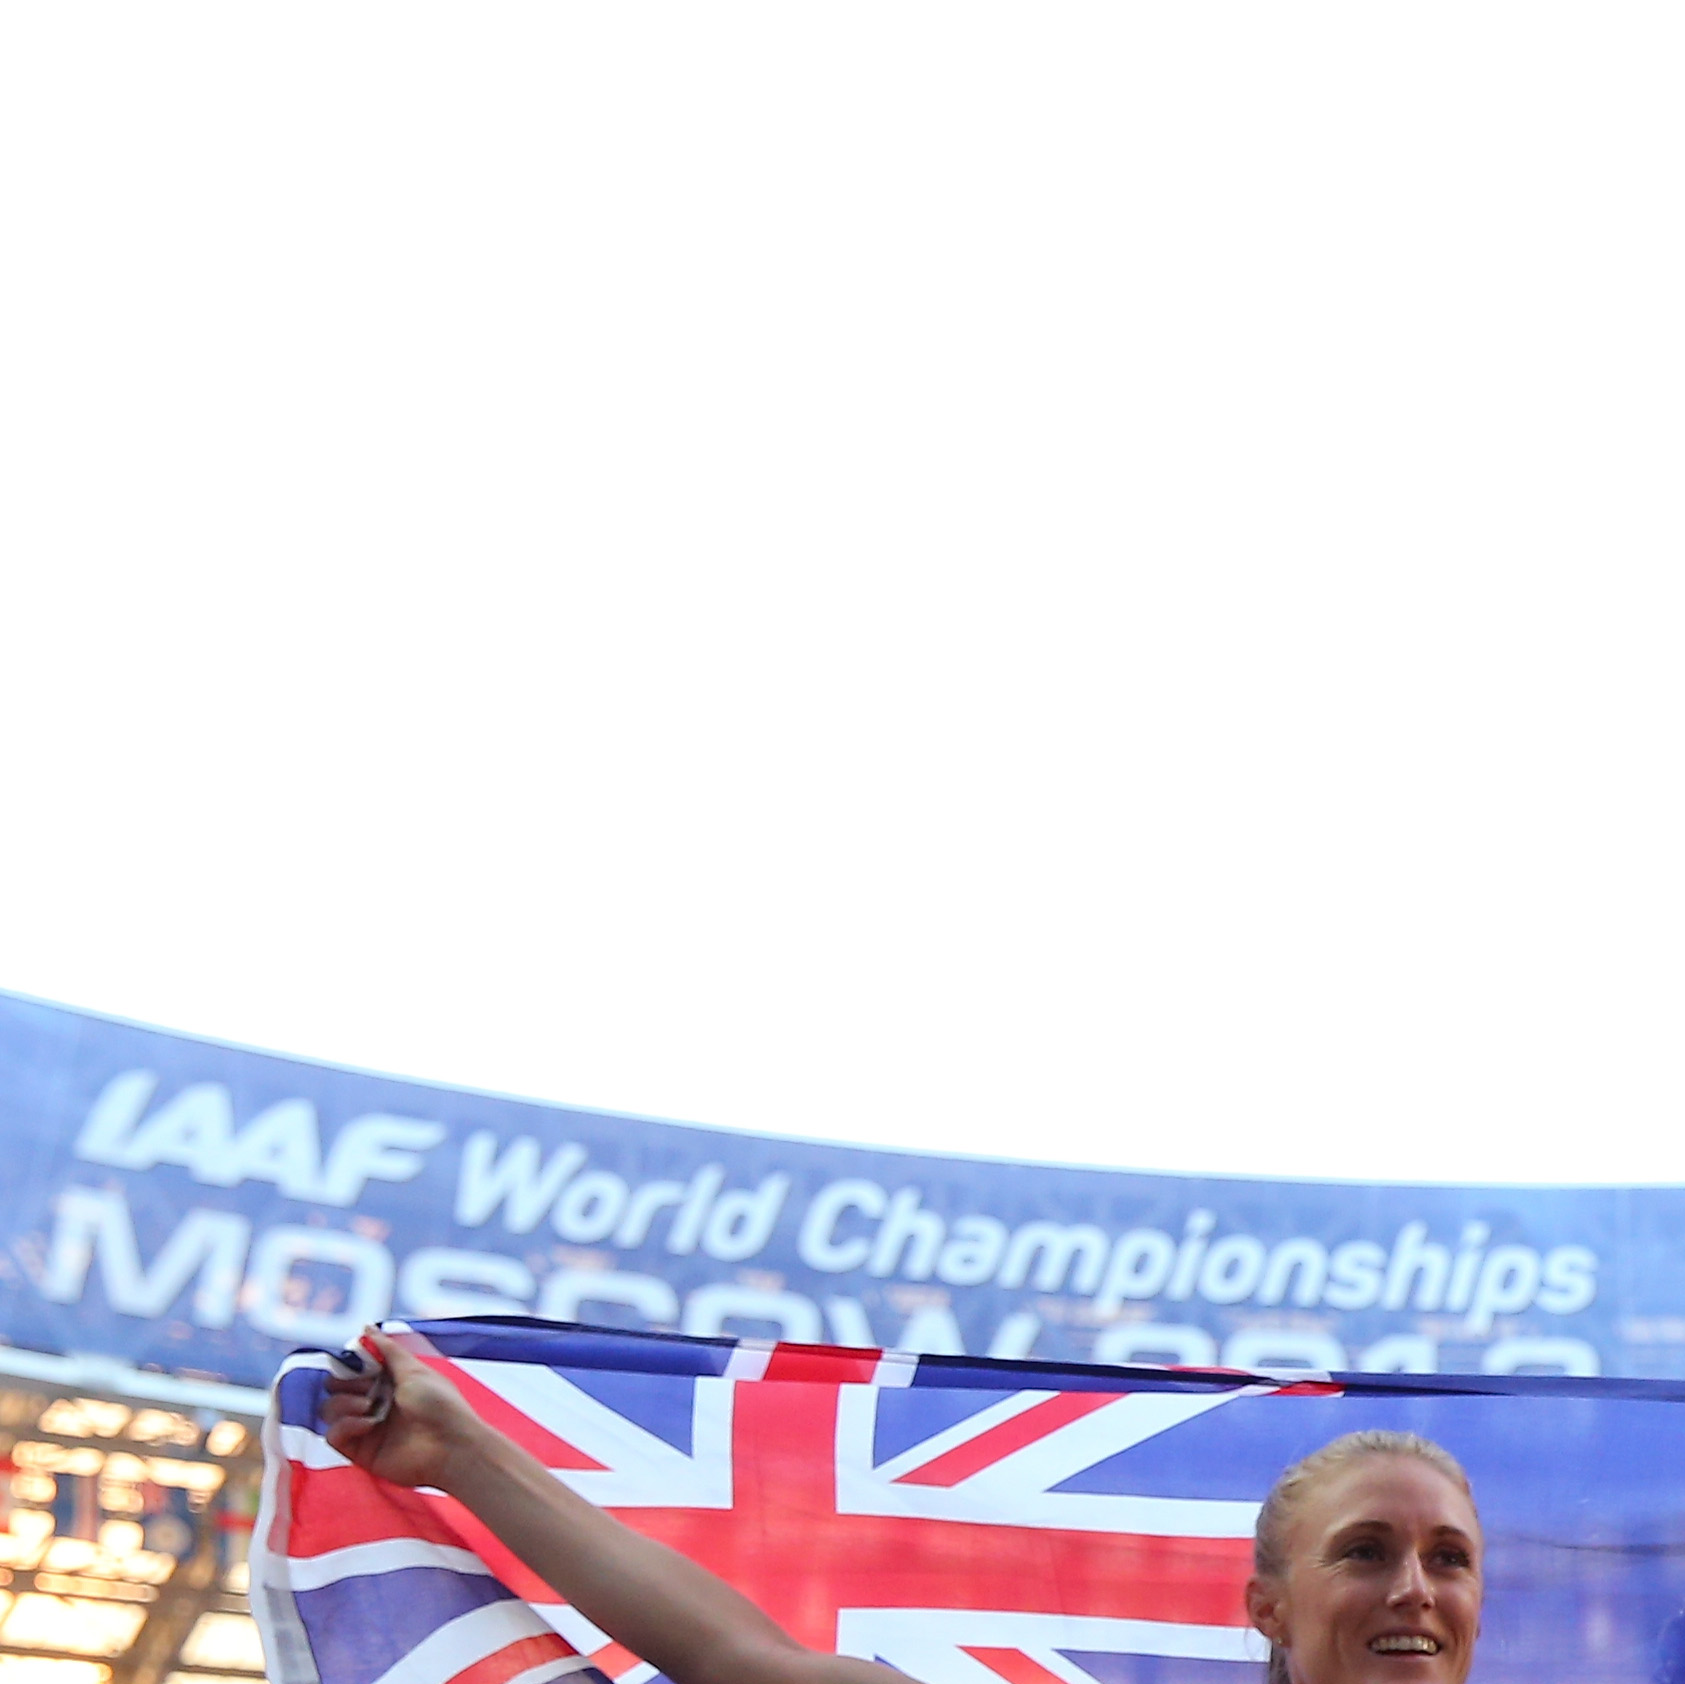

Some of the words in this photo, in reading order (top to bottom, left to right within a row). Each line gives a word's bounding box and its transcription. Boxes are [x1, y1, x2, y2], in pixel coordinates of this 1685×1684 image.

[74, 1068, 446, 1208] IAAF
[455, 1128, 789, 1263] World
[798, 1176, 1598, 1336] Championships
